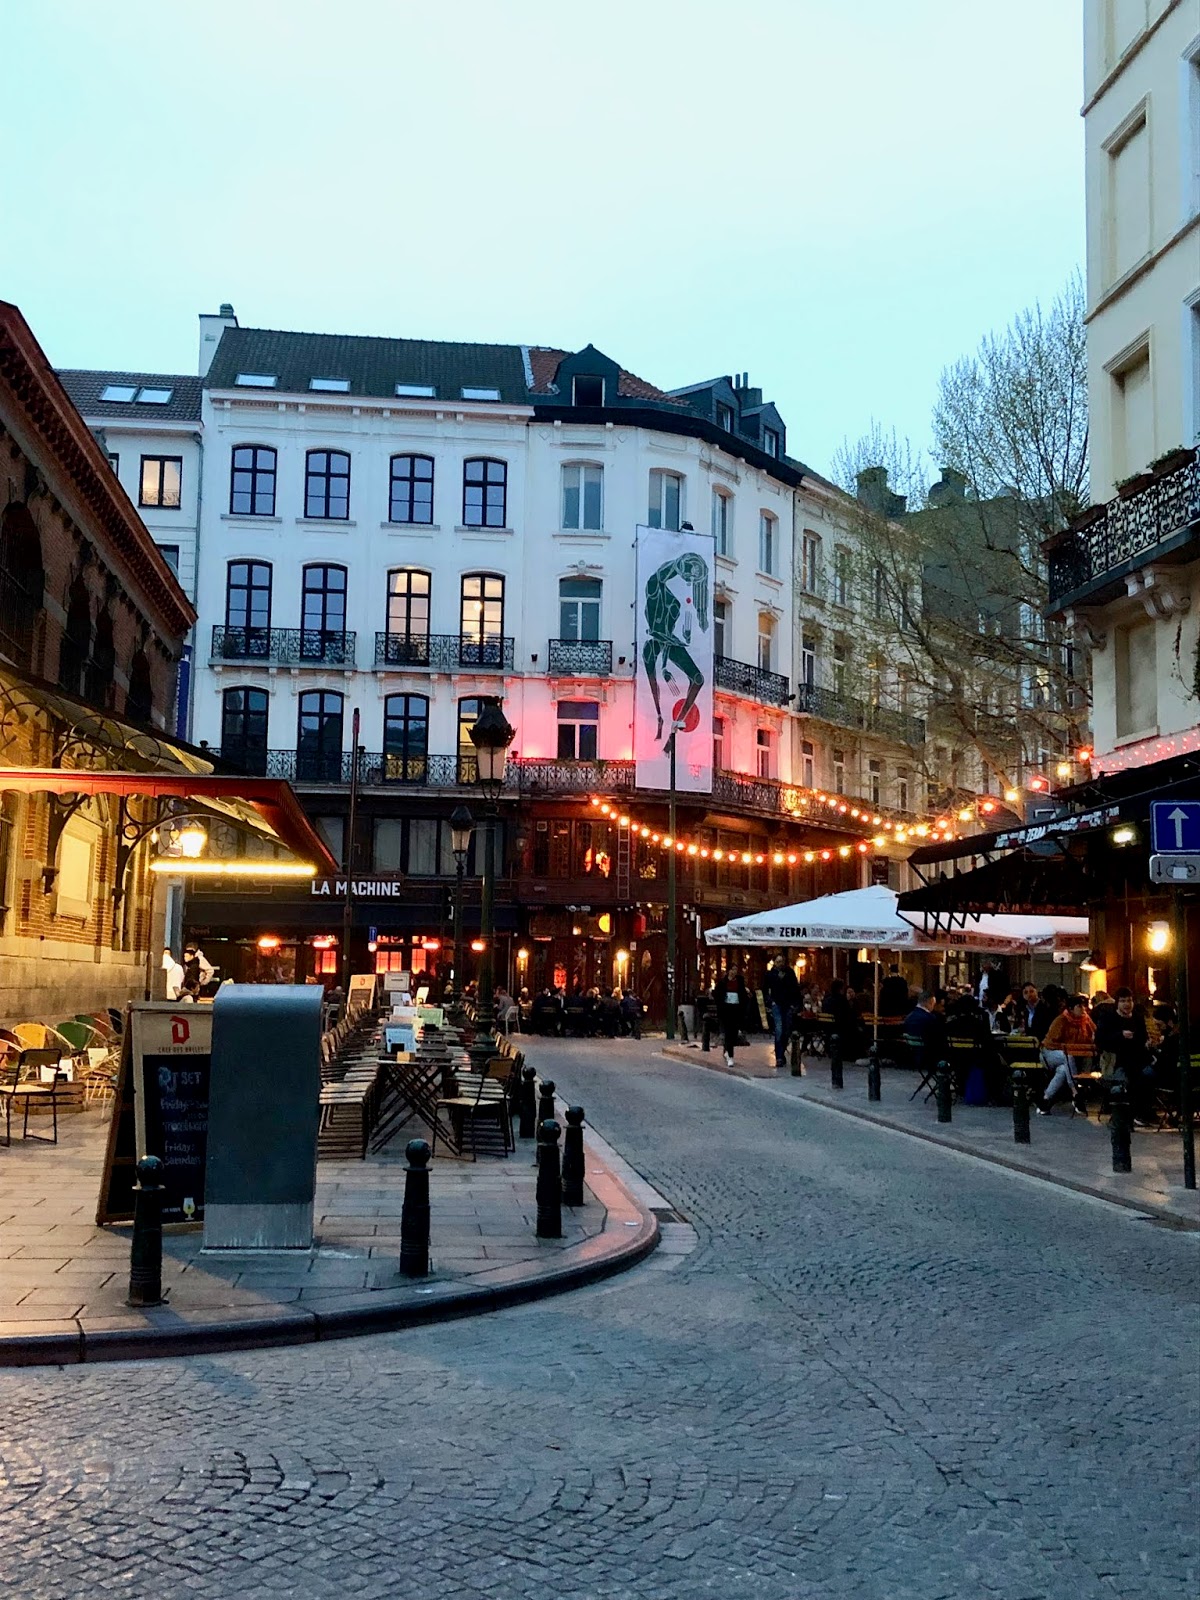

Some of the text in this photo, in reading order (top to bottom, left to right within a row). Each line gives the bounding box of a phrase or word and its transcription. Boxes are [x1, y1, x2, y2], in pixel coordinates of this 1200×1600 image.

[311, 880, 401, 897] LA MACHINE
[779, 926, 808, 939] ZEBRA
[181, 1071, 202, 1085] SET
